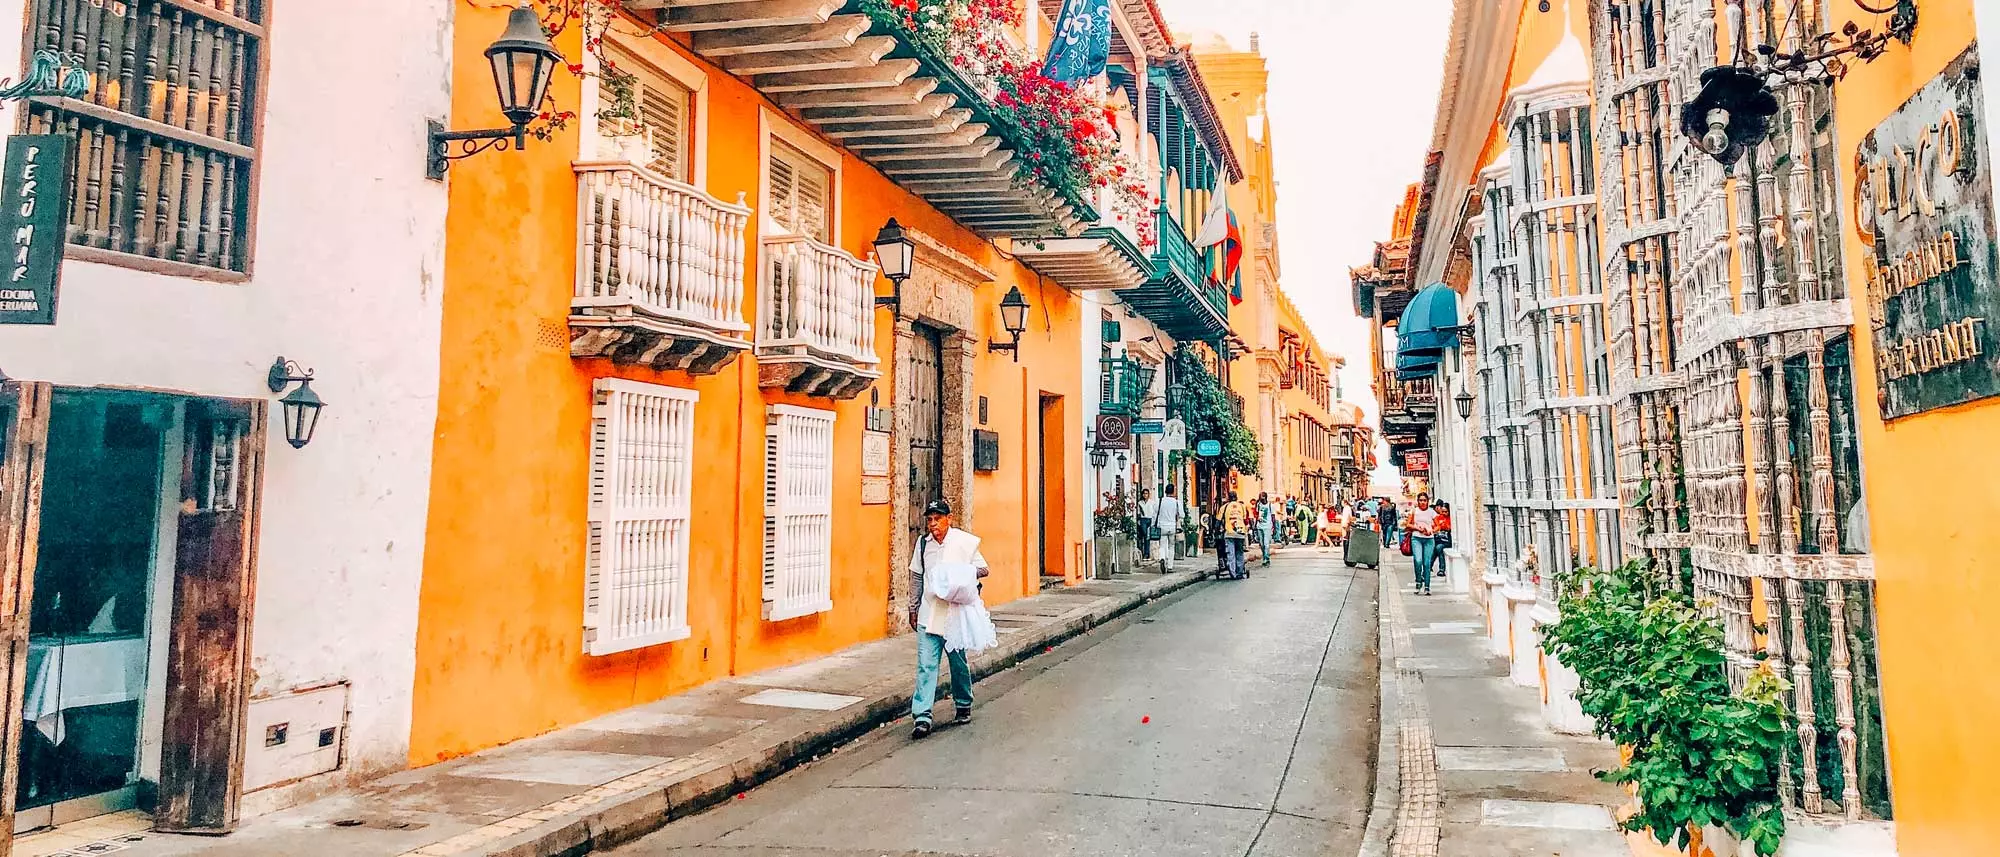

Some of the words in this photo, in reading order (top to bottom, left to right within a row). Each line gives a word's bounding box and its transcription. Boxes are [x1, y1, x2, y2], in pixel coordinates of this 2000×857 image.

[1854, 107, 1961, 248] CUZCO
[12, 224, 34, 282] MAR
[1879, 230, 1957, 300] COCINA
[0, 289, 36, 300] COCINA
[0, 301, 39, 311] ERUANA
[1879, 316, 1977, 385] PERUANA
